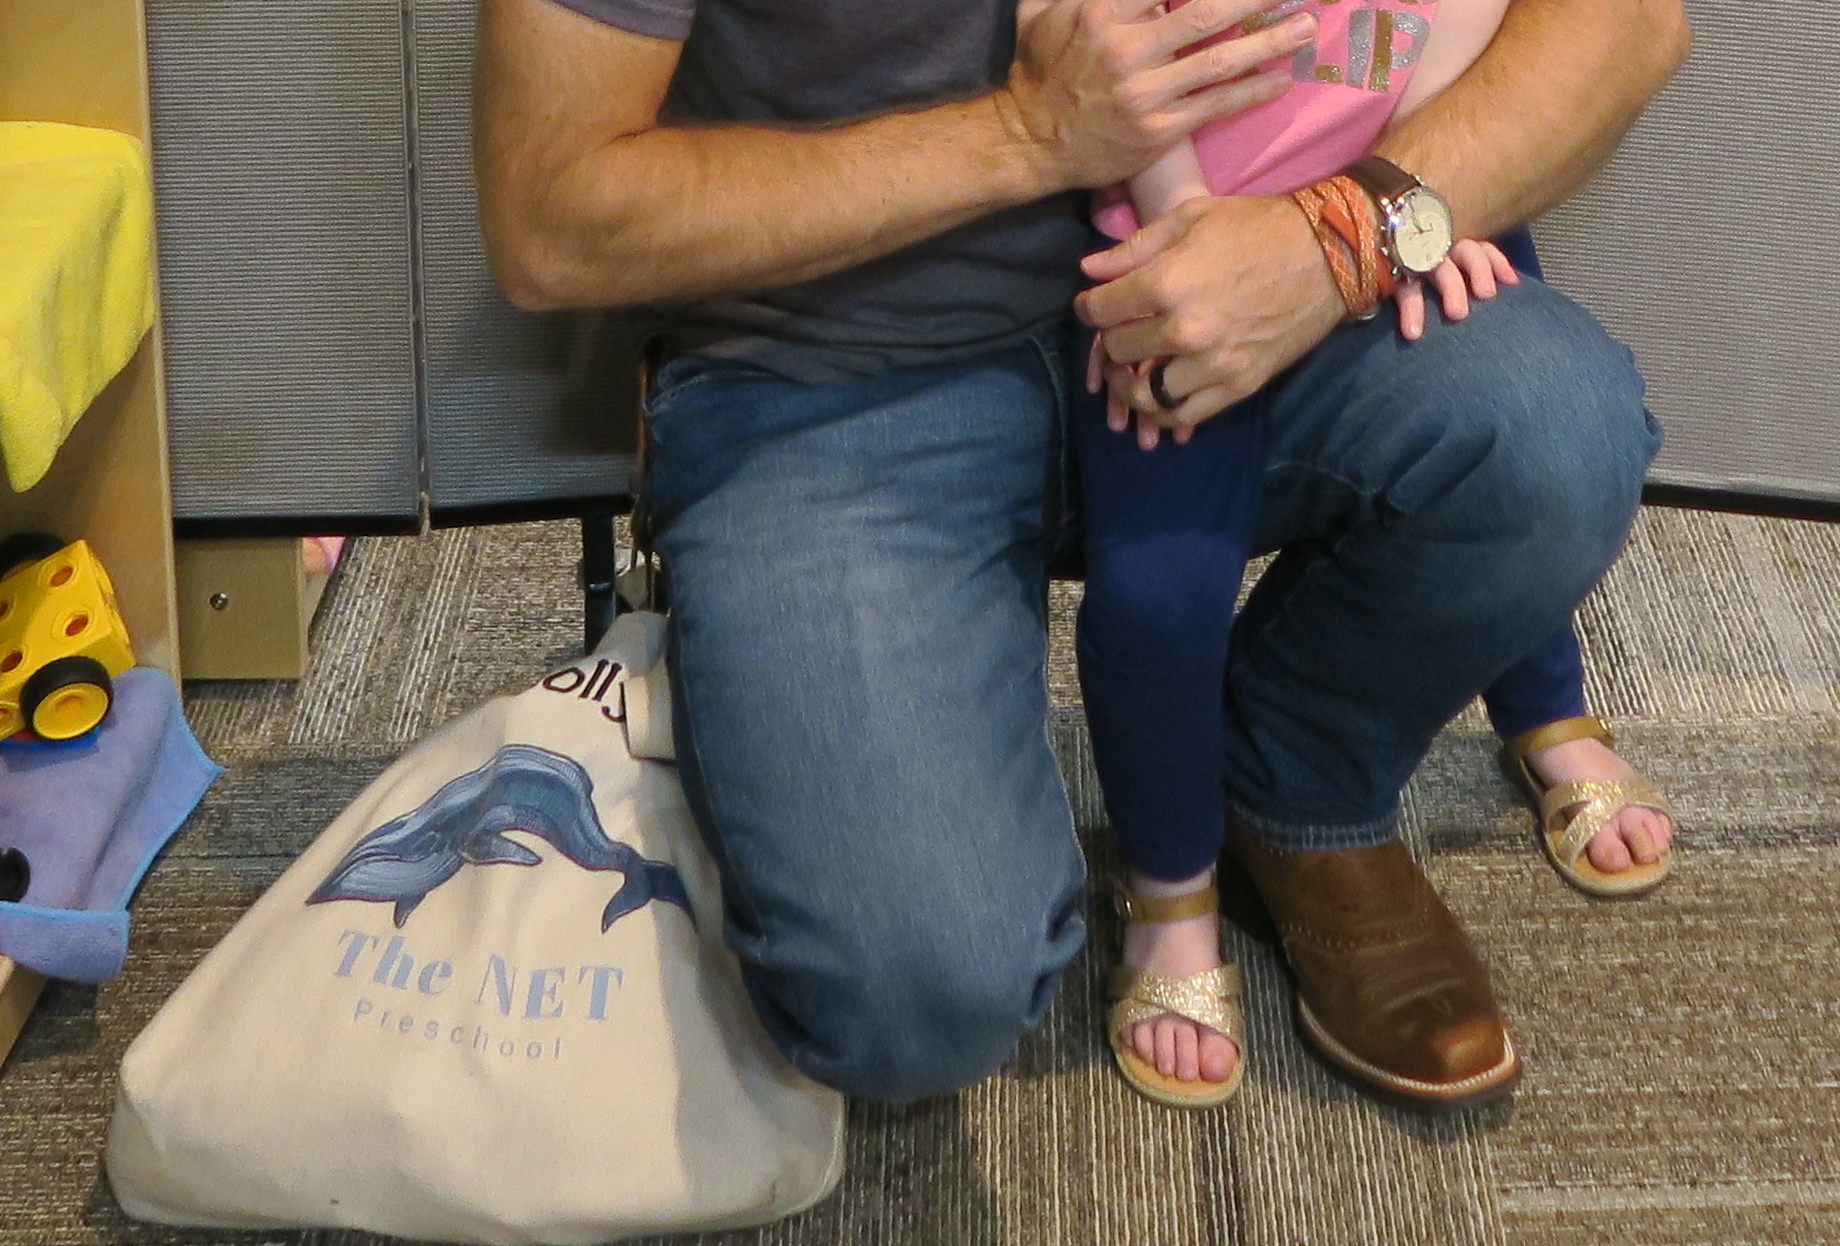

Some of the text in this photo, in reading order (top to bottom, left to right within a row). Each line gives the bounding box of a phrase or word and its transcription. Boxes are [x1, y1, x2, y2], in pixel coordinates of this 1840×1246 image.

[1241, 8, 1431, 93] LIP
[332, 928, 625, 1022] The NET
[353, 998, 562, 1060] Preschool
